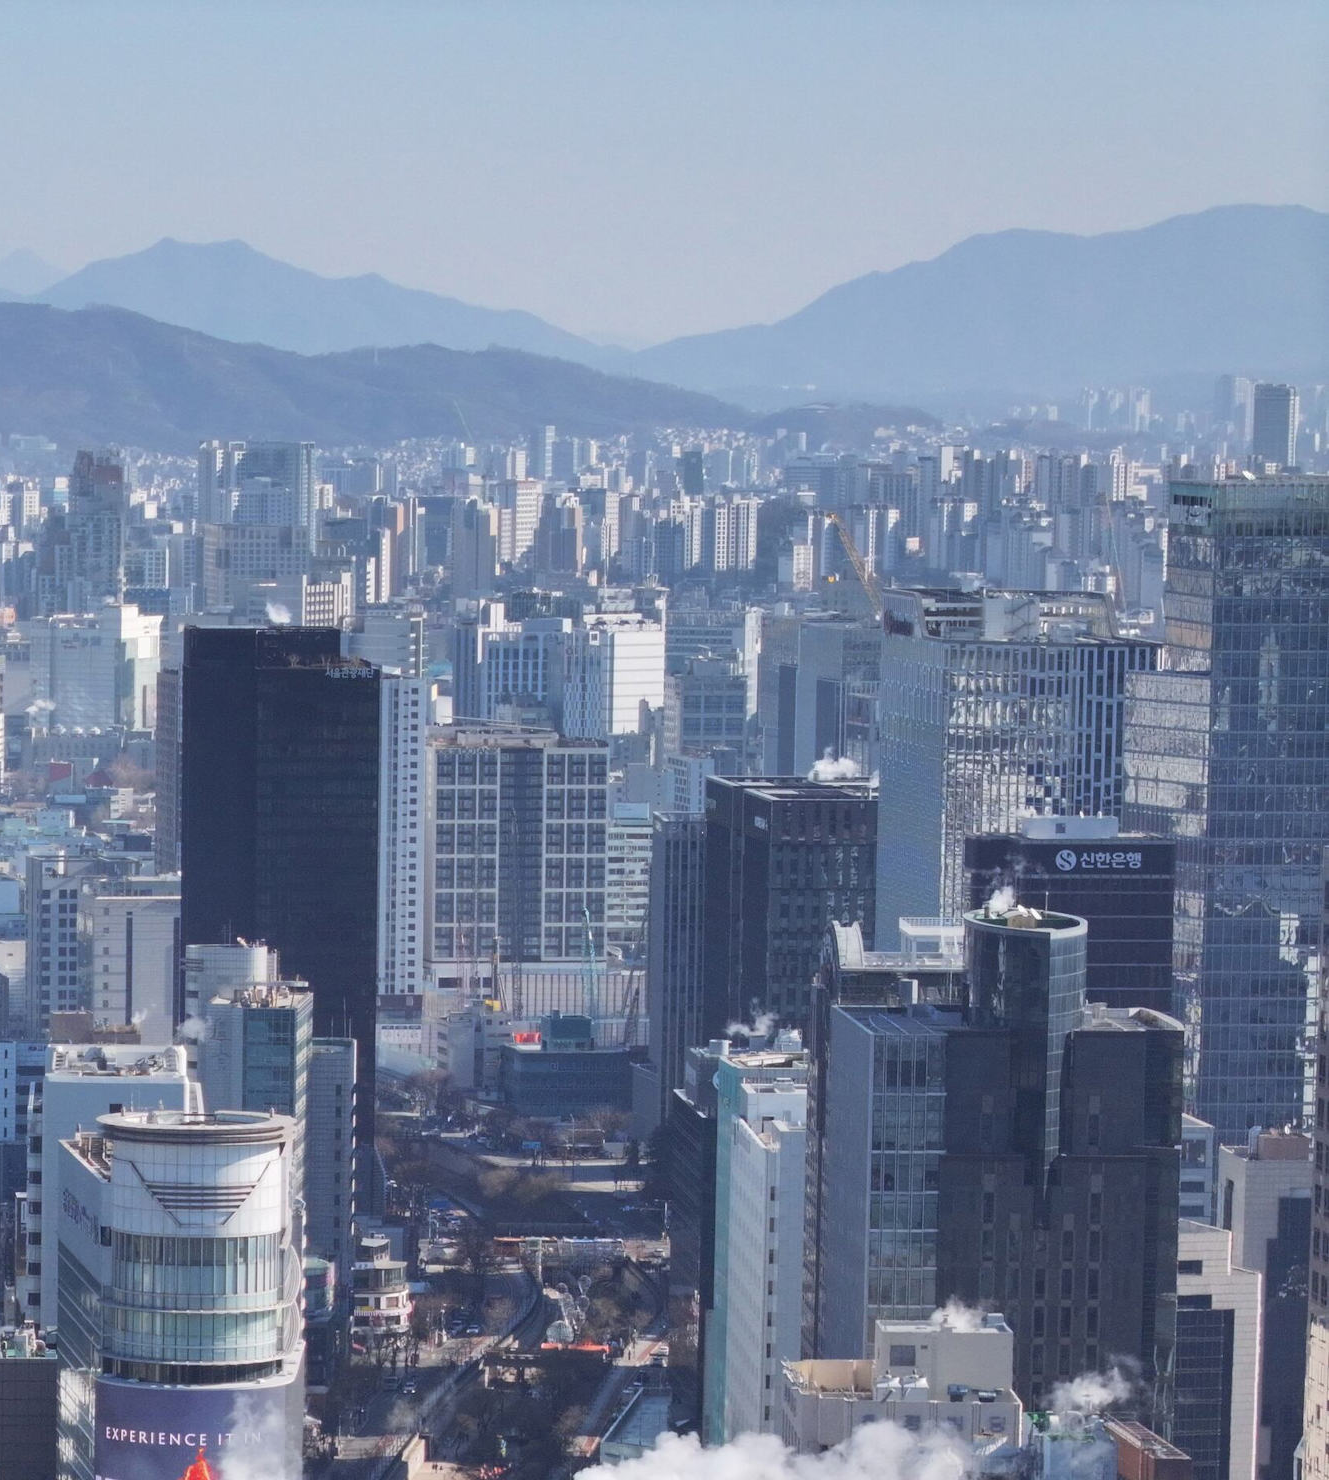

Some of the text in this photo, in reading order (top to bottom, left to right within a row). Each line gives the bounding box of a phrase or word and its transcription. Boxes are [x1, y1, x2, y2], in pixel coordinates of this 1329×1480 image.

[325, 667, 374, 680] 서울관광재단
[1080, 851, 1142, 869] 신한은행
[105, 1426, 207, 1446] EXPERIENCE
